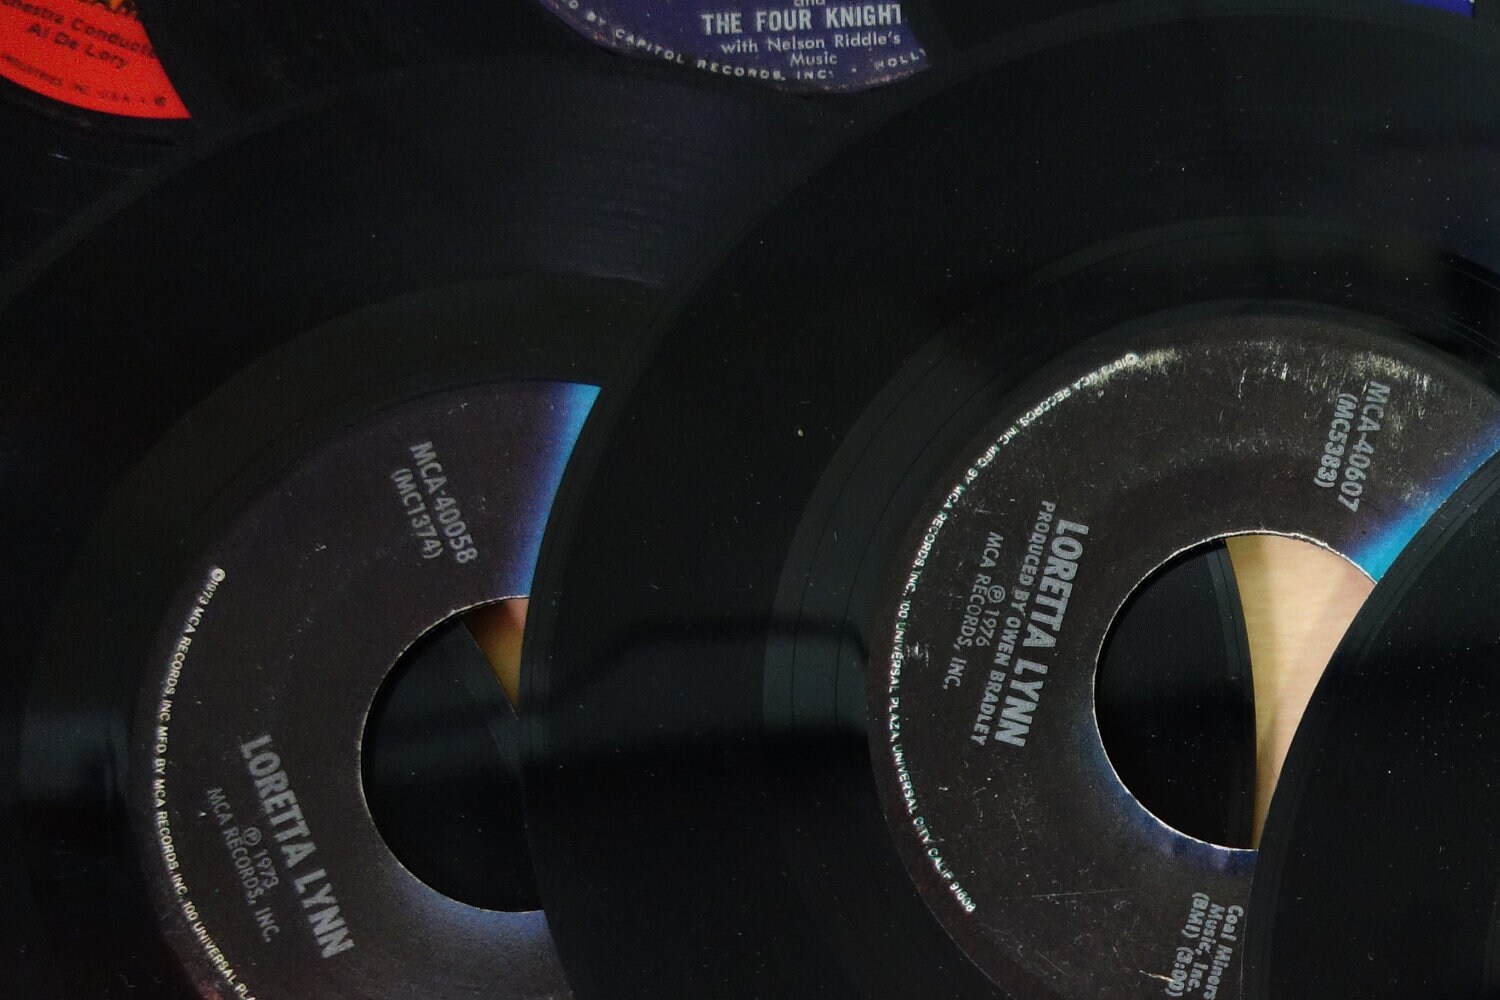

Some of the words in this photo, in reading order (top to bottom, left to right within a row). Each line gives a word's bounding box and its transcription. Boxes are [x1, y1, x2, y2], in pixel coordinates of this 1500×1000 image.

[700, 12, 743, 36] THE
[757, 9, 812, 33] FOUR
[720, 40, 758, 55] with
[767, 35, 825, 52] Nelson
[834, 31, 902, 49] Riddle's
[615, 28, 686, 64] CAPITOL
[790, 51, 837, 67] Music
[1313, 392, 1359, 488] (MC5383)
[1337, 380, 1391, 513] MCA-40607
[943, 483, 966, 509] MCA
[963, 466, 979, 485] BY
[389, 467, 444, 559] (MC1374)
[409, 440, 479, 564] MCA-40058
[979, 531, 1004, 568] MCA
[1019, 500, 1057, 586] PRODUCED
[1010, 588, 1031, 618] BY
[1022, 519, 1090, 648] LORETTA
[184, 606, 205, 634] MCA
[897, 599, 911, 620] 100
[953, 573, 992, 650] RECORDS,
[975, 608, 1000, 648] 1976
[888, 622, 907, 694] UNIVERSAL
[993, 616, 1022, 668] OWEN
[942, 657, 967, 690] INC.
[970, 669, 1006, 746] BRADLEY
[994, 658, 1049, 747] LYNN
[153, 758, 166, 775] BY
[891, 743, 918, 815] UNIVERSAL
[152, 778, 167, 808] MCA
[206, 787, 234, 826] MCA
[254, 906, 280, 943] INC.
[240, 734, 317, 869] LORETTA
[294, 867, 355, 959] LYNN
[253, 848, 279, 889] 1973
[182, 901, 199, 921] 100
[1181, 892, 1210, 938] (BMI)
[1195, 903, 1225, 955] Music,
[1221, 904, 1244, 942] Coal
[191, 921, 237, 985] UNIVERSAL
[1163, 946, 1195, 997] (3:00)
[1186, 962, 1209, 993] Inc.
